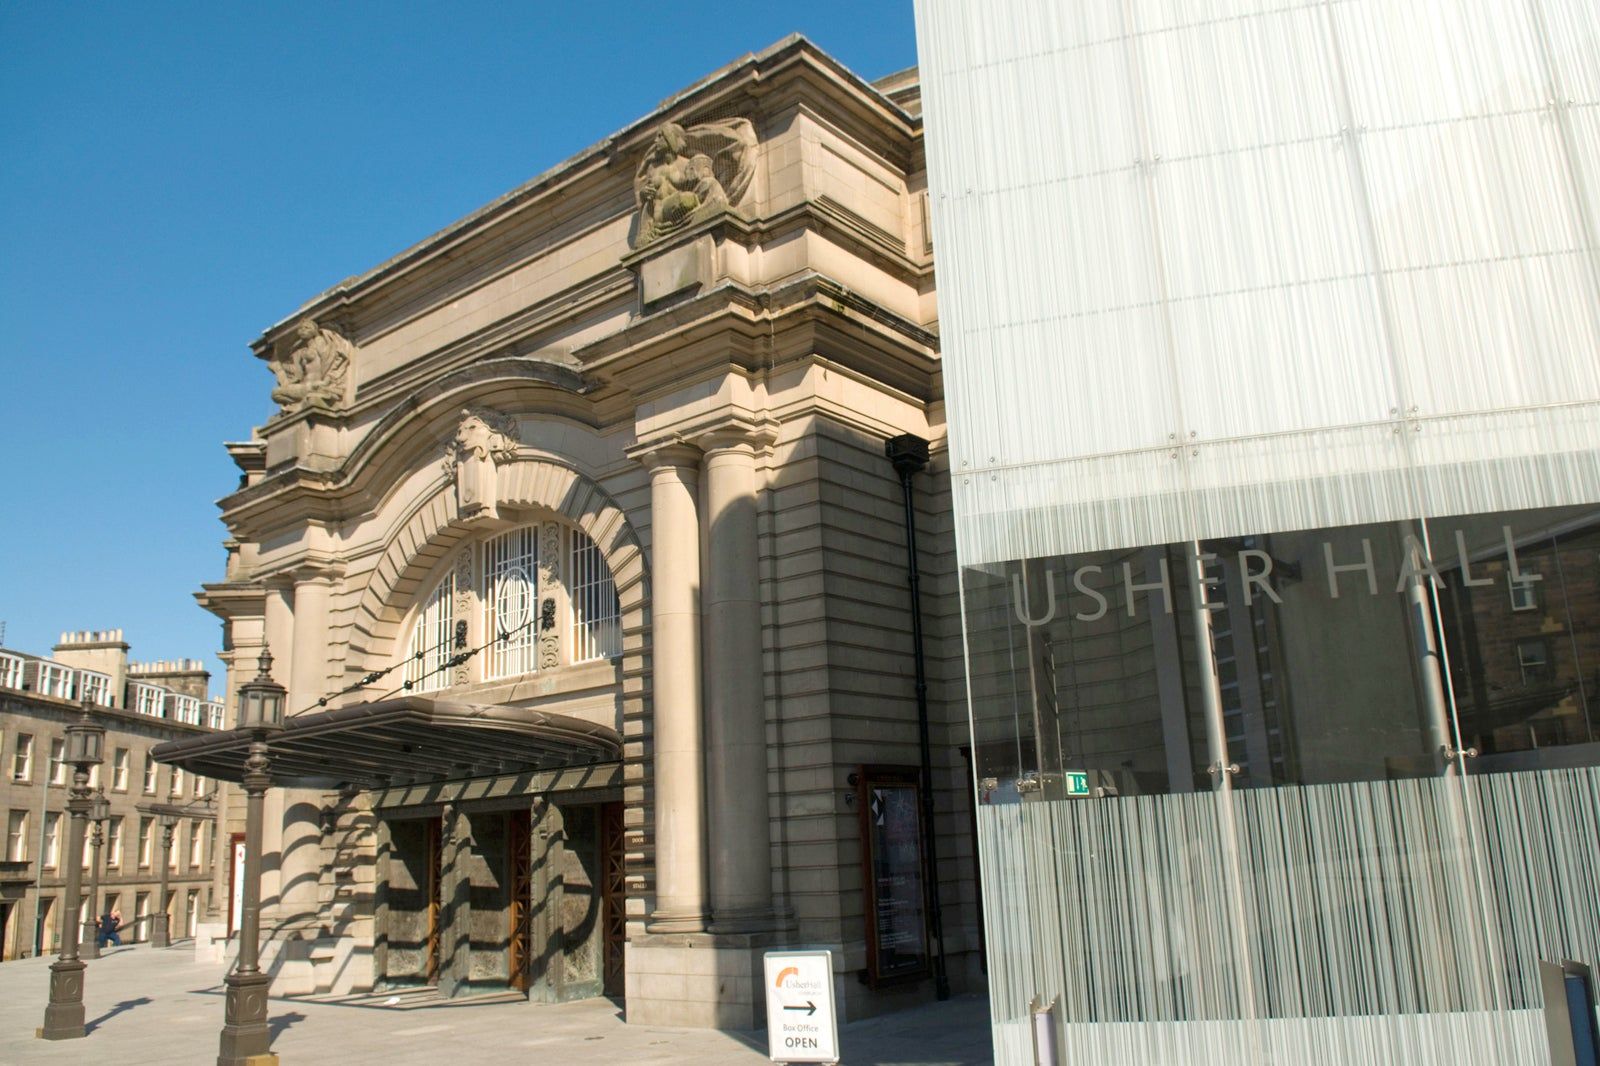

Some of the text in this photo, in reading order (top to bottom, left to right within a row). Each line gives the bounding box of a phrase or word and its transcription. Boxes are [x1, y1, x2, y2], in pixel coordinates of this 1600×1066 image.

[1012, 525, 1543, 626] USHER HALL
[783, 1024, 819, 1032] Box Office
[785, 1037, 818, 1048] OPEN
